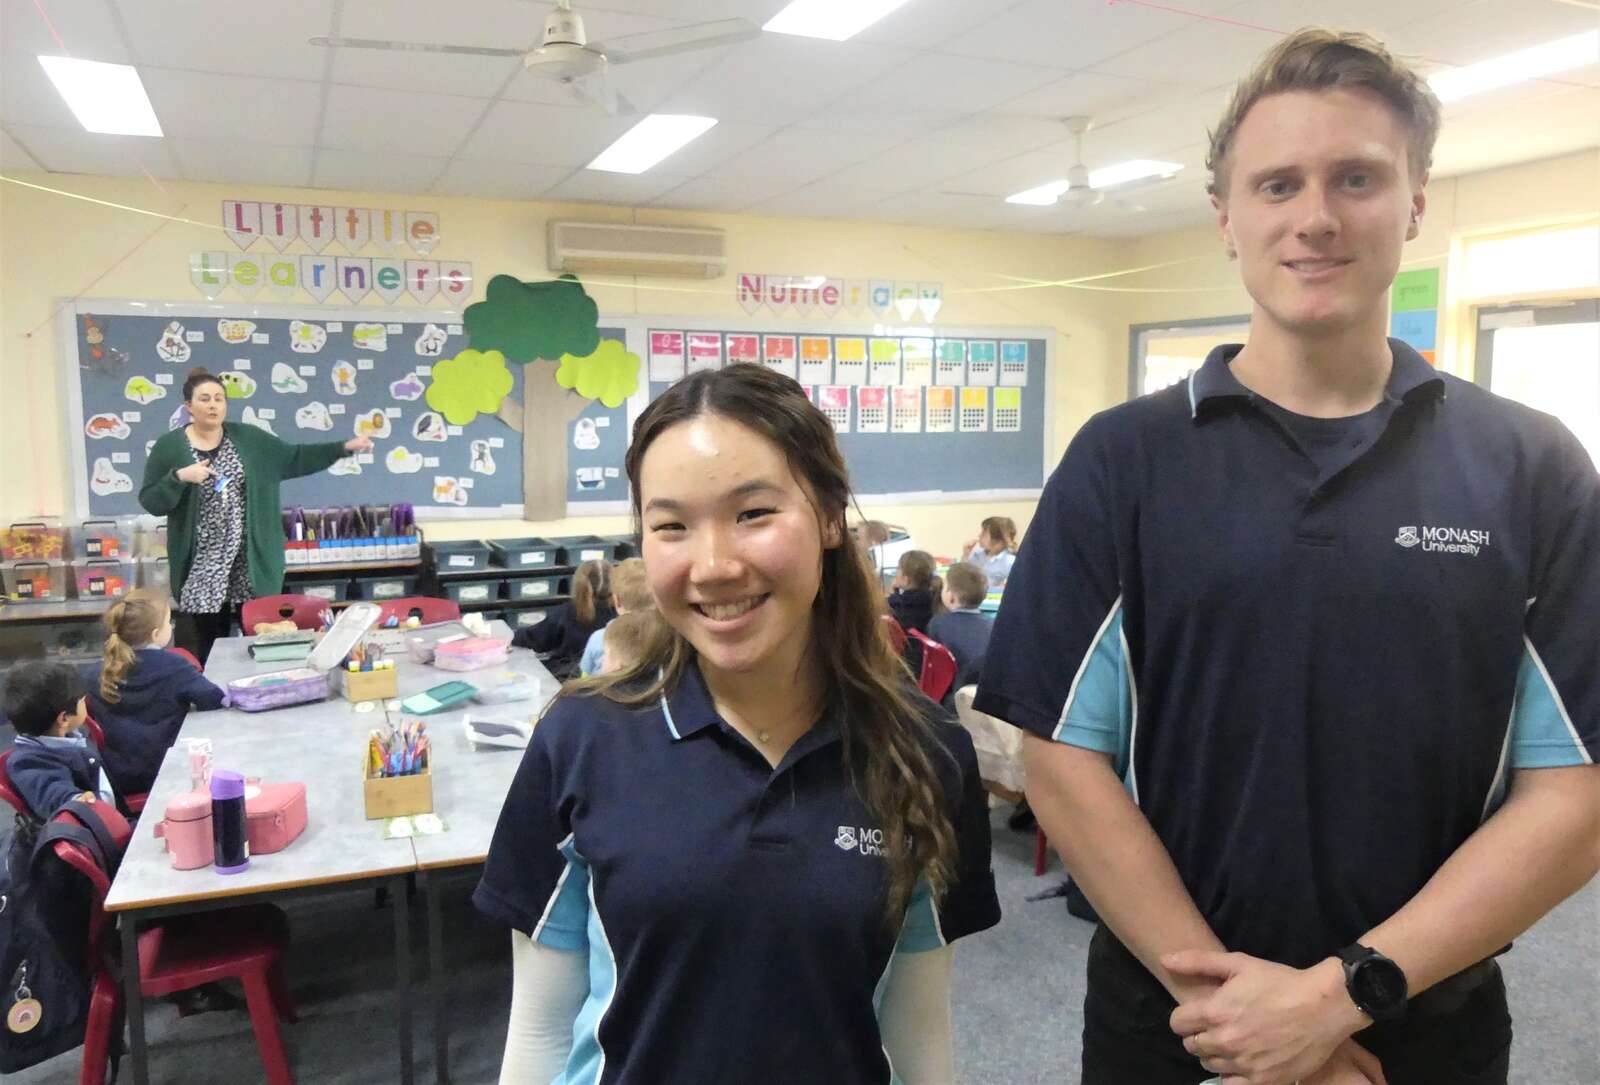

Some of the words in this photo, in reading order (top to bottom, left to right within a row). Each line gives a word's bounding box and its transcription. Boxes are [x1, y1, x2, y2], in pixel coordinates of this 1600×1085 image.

[234, 203, 434, 240] Little
[202, 253, 464, 292] Learners
[1422, 526, 1490, 546] MONASH
[1422, 541, 1480, 557] University
